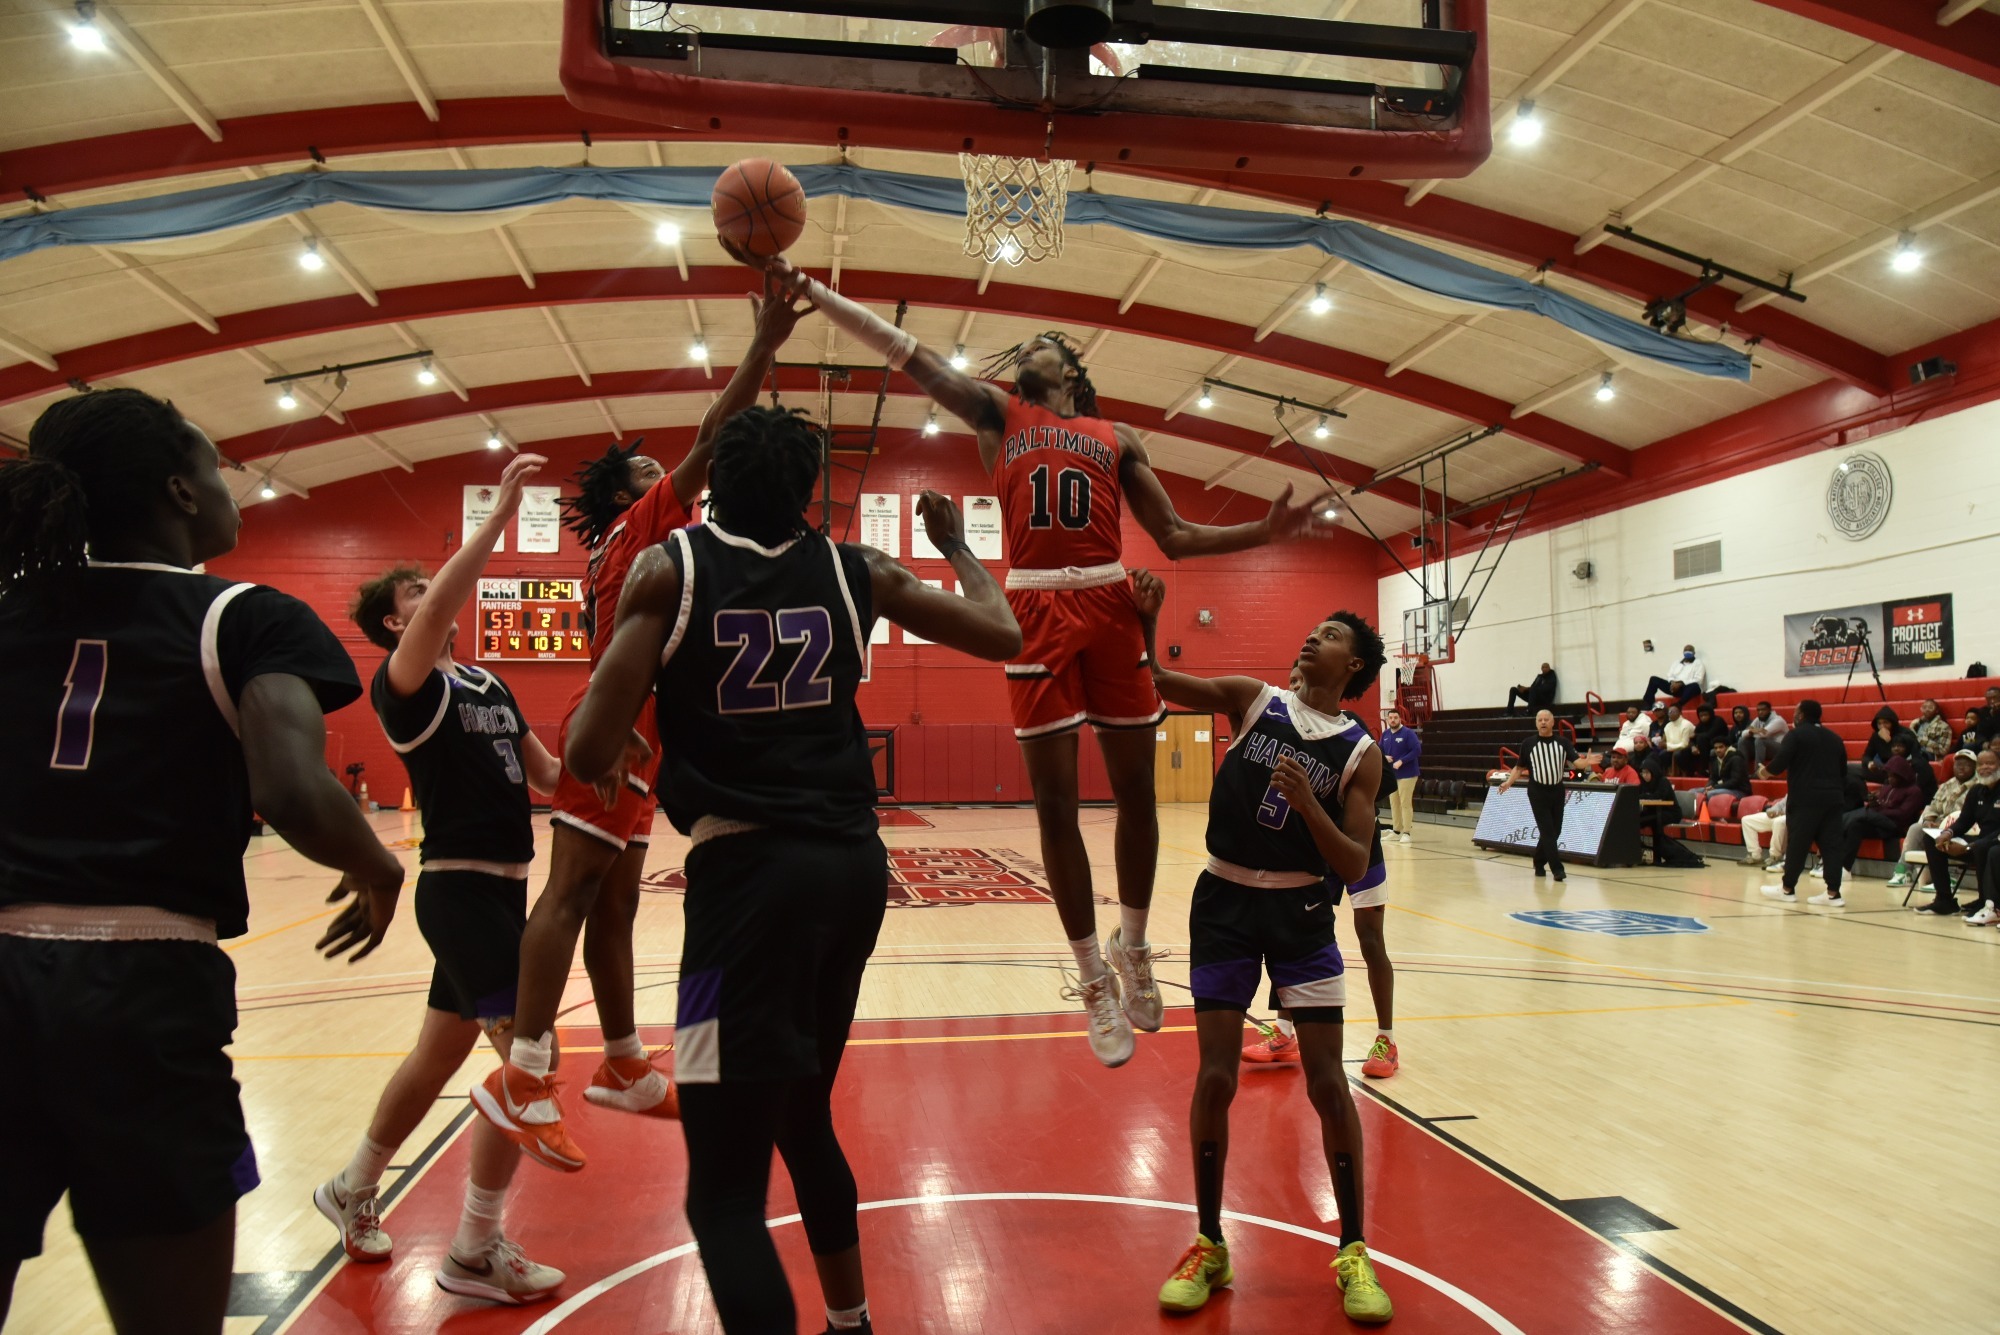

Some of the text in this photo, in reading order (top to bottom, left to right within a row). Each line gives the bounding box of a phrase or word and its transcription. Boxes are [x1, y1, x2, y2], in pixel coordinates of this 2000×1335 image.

[1005, 426, 1116, 476] BALTIMORE
[1867, 465, 1882, 490] COLLEGE
[1029, 464, 1092, 531] 10
[483, 582, 516, 590] BCCC
[528, 582, 572, 599] 11:24
[481, 602, 522, 610] PANTHERS
[491, 611, 514, 629] 53
[541, 613, 551, 628] 2
[1892, 622, 1941, 643] PROTECT
[491, 636, 499, 650] 3
[509, 637, 520, 650] 4
[572, 637, 582, 650] 4
[1892, 642, 1910, 656] THIS
[713, 605, 833, 715] 22
[1800, 645, 1865, 667] BCCC
[50, 638, 107, 770] 1
[1256, 772, 1291, 831] 5
